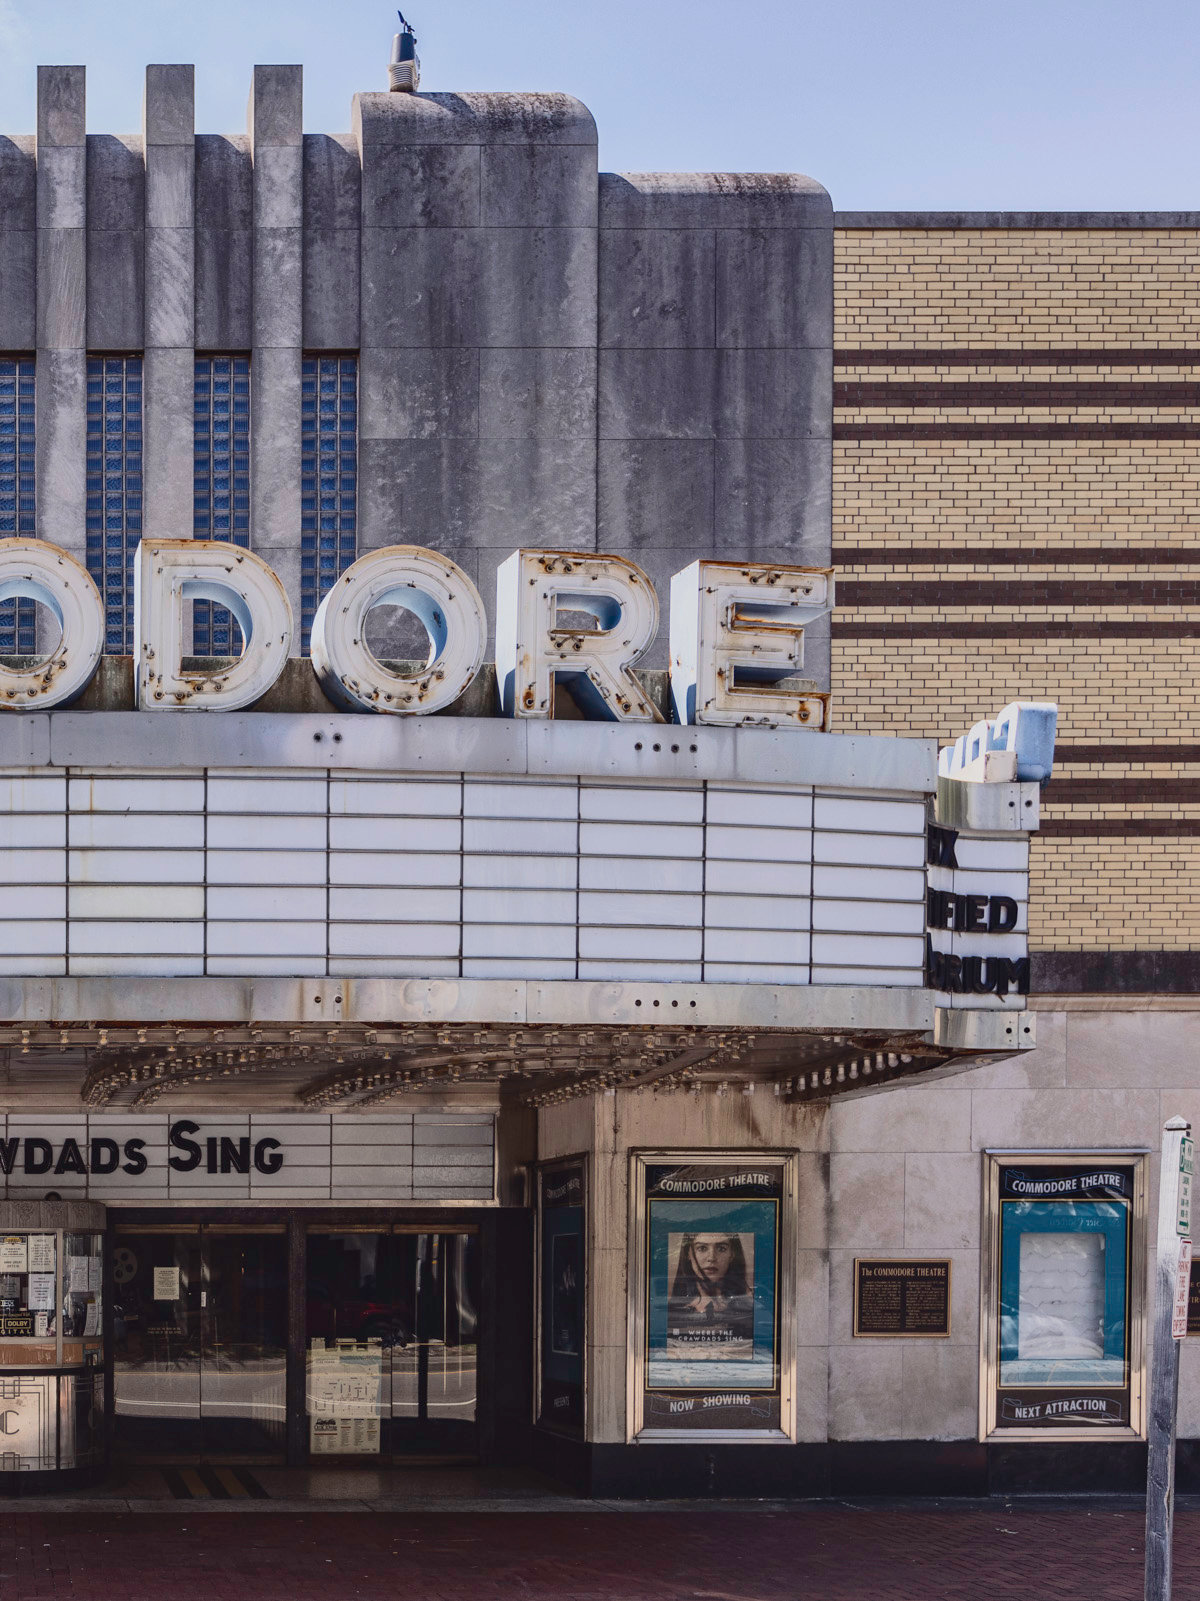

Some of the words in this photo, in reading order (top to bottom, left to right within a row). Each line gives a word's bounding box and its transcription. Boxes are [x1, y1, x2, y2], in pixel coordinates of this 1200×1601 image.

[661, 1179, 725, 1192] COMMODORE
[729, 1173, 769, 1186] THEATRE
[1012, 1179, 1077, 1193] COMMODORE
[1080, 1174, 1120, 1188] THEATRE
[862, 1267, 872, 1276] The
[873, 1267, 915, 1276] COMMODORE
[917, 1267, 946, 1276] THEATRE
[670, 1400, 694, 1413] NOW
[703, 1394, 751, 1408] SHOWING
[1015, 1406, 1040, 1418] NEXT
[1045, 1399, 1106, 1415] ATTRACTION
